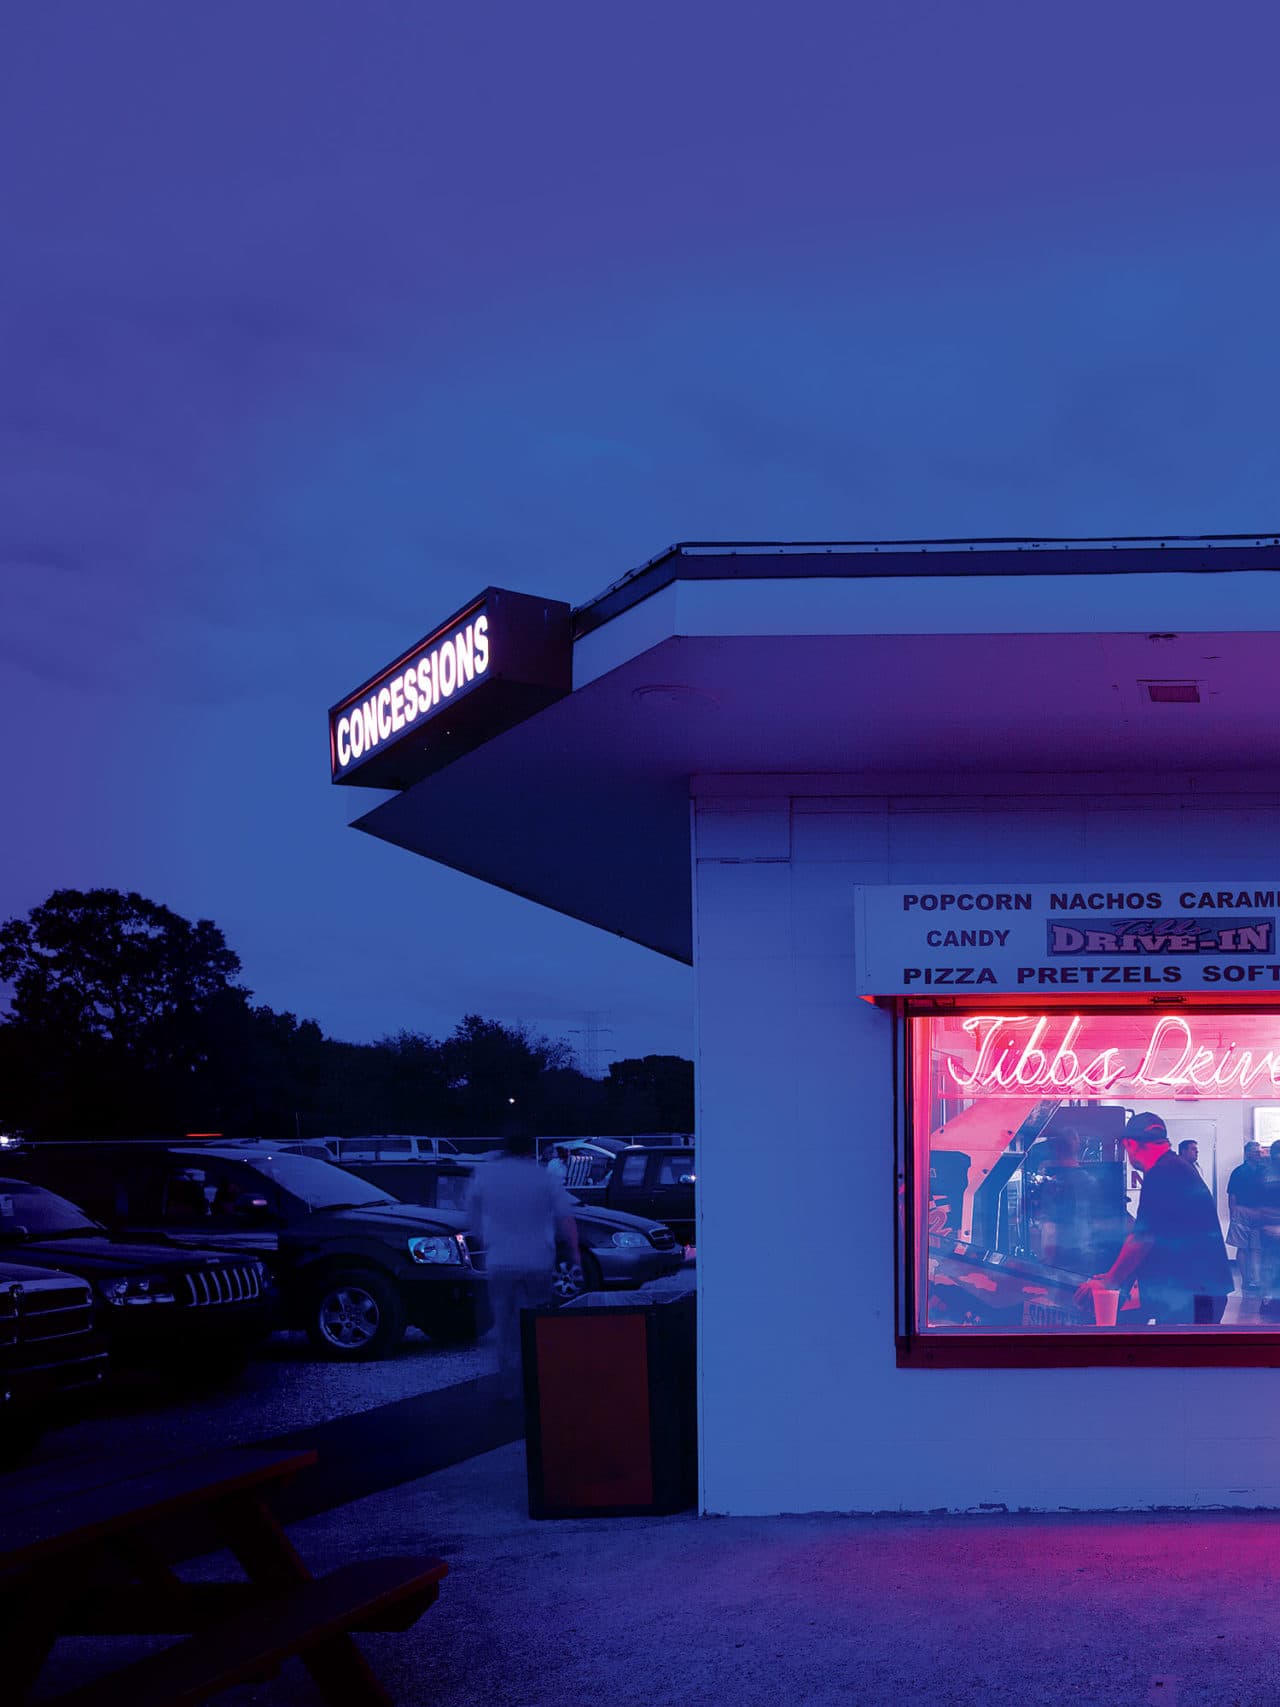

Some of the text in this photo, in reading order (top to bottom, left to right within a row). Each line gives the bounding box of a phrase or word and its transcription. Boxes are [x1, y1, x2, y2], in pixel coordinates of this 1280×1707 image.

[337, 615, 489, 767] CONCESSIONS
[903, 893, 1032, 911] POPCORN
[1050, 892, 1162, 910] NACHOS
[926, 930, 1010, 948] CANDY
[1051, 922, 1271, 952] DRIVE-IN
[903, 967, 998, 985] PIZZA
[1017, 966, 1182, 984] PRETZELS
[947, 1016, 1126, 1087] Tibbs
